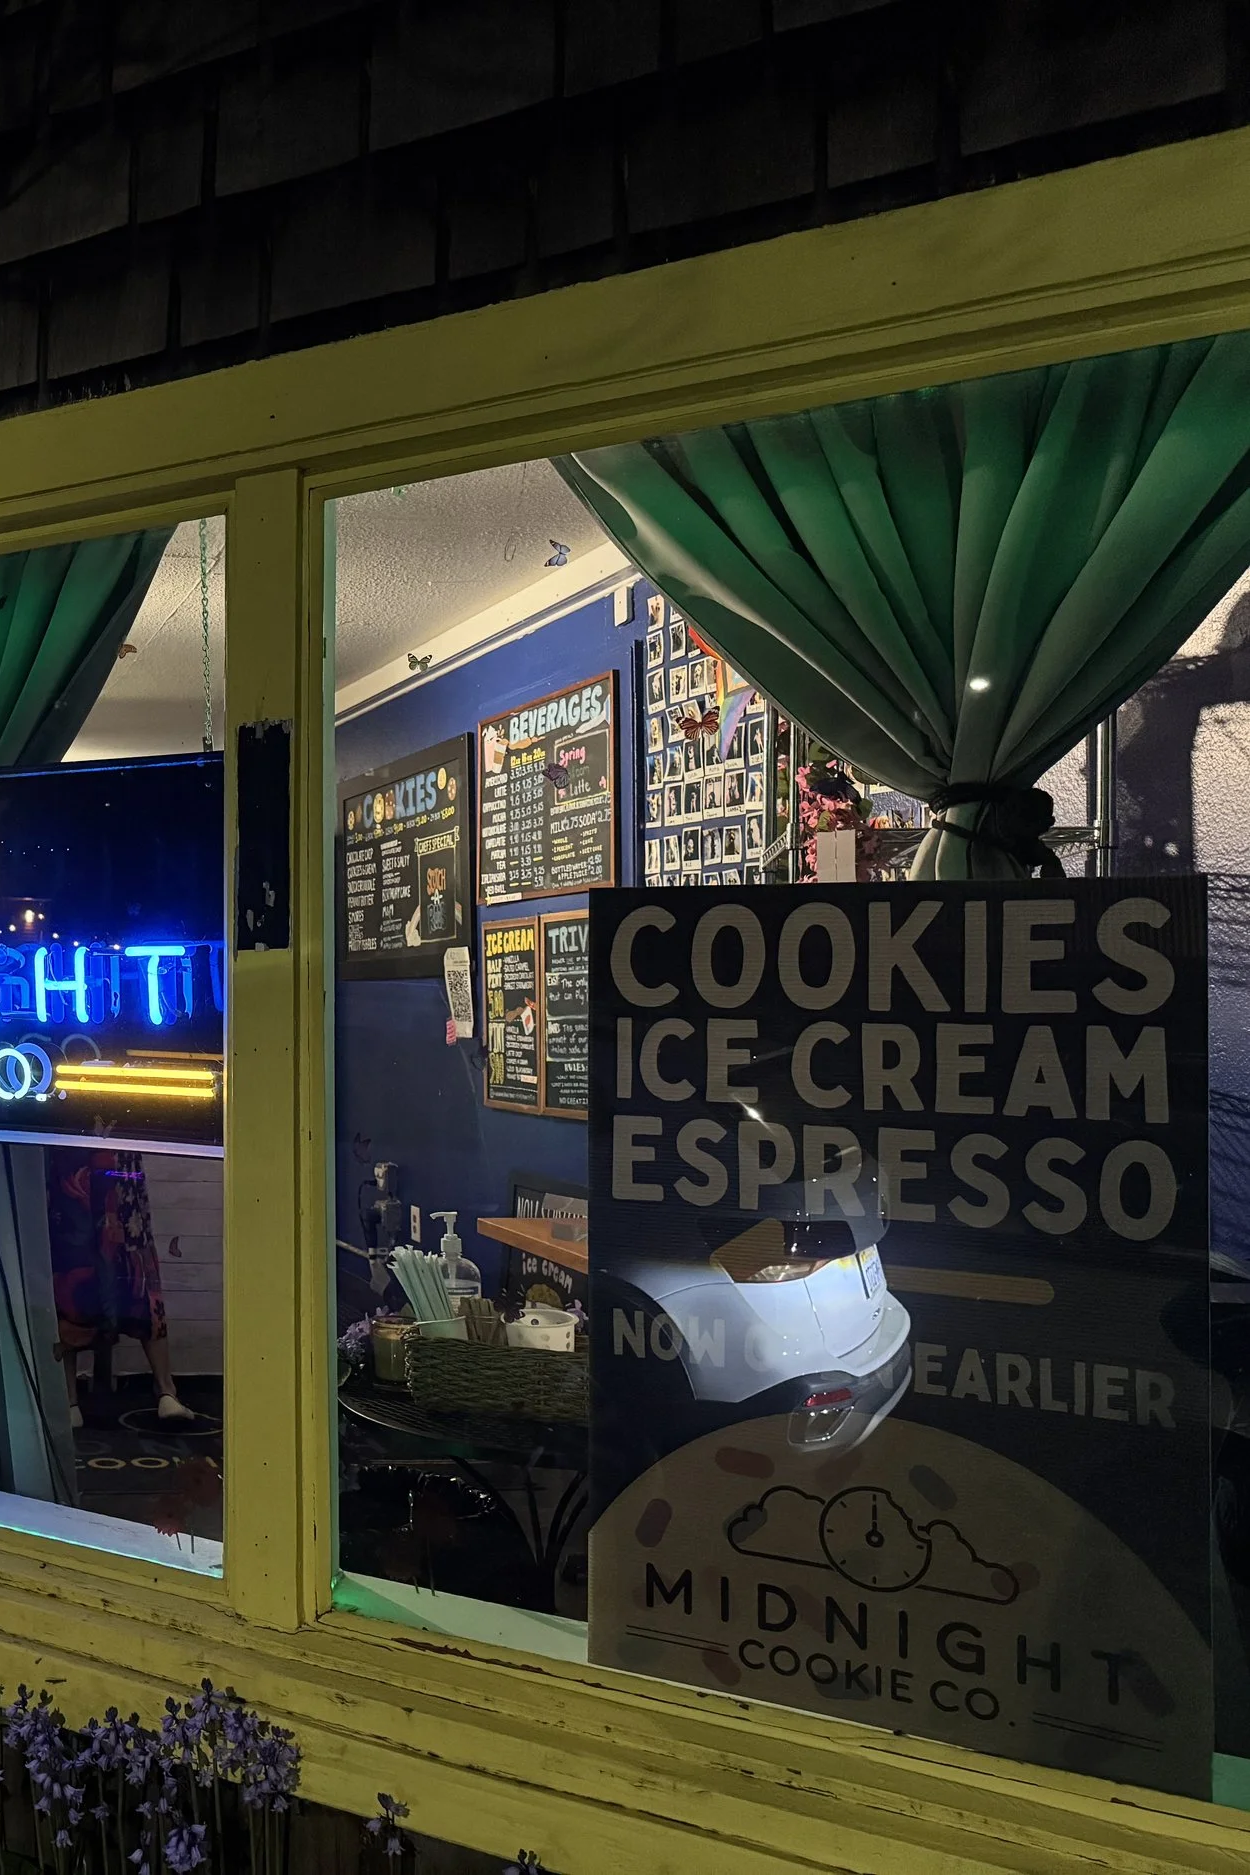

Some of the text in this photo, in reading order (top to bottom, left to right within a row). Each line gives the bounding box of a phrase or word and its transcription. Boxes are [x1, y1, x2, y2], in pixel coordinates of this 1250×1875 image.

[510, 685, 602, 745] BEVERAGES
[559, 746, 585, 767] Spring
[363, 771, 437, 828] COOKIES
[570, 779, 591, 796] Latte
[431, 835, 453, 849] SPECIAL
[579, 811, 596, 827] SODA
[486, 928, 534, 957] ICE CREAM
[610, 897, 1176, 1016] COOKIES
[487, 973, 502, 989] PINT
[488, 1022, 505, 1053] PINT
[616, 1017, 1170, 1124] ICE CREAM
[612, 1114, 1177, 1242] ESPRESSO
[522, 1252, 573, 1294] ice cream
[612, 1307, 726, 1368] NOW
[915, 1343, 1177, 1428] EARLIER
[645, 1562, 1142, 1705] MIDNIGHT
[738, 1639, 1017, 1727] COOKIE CO.
